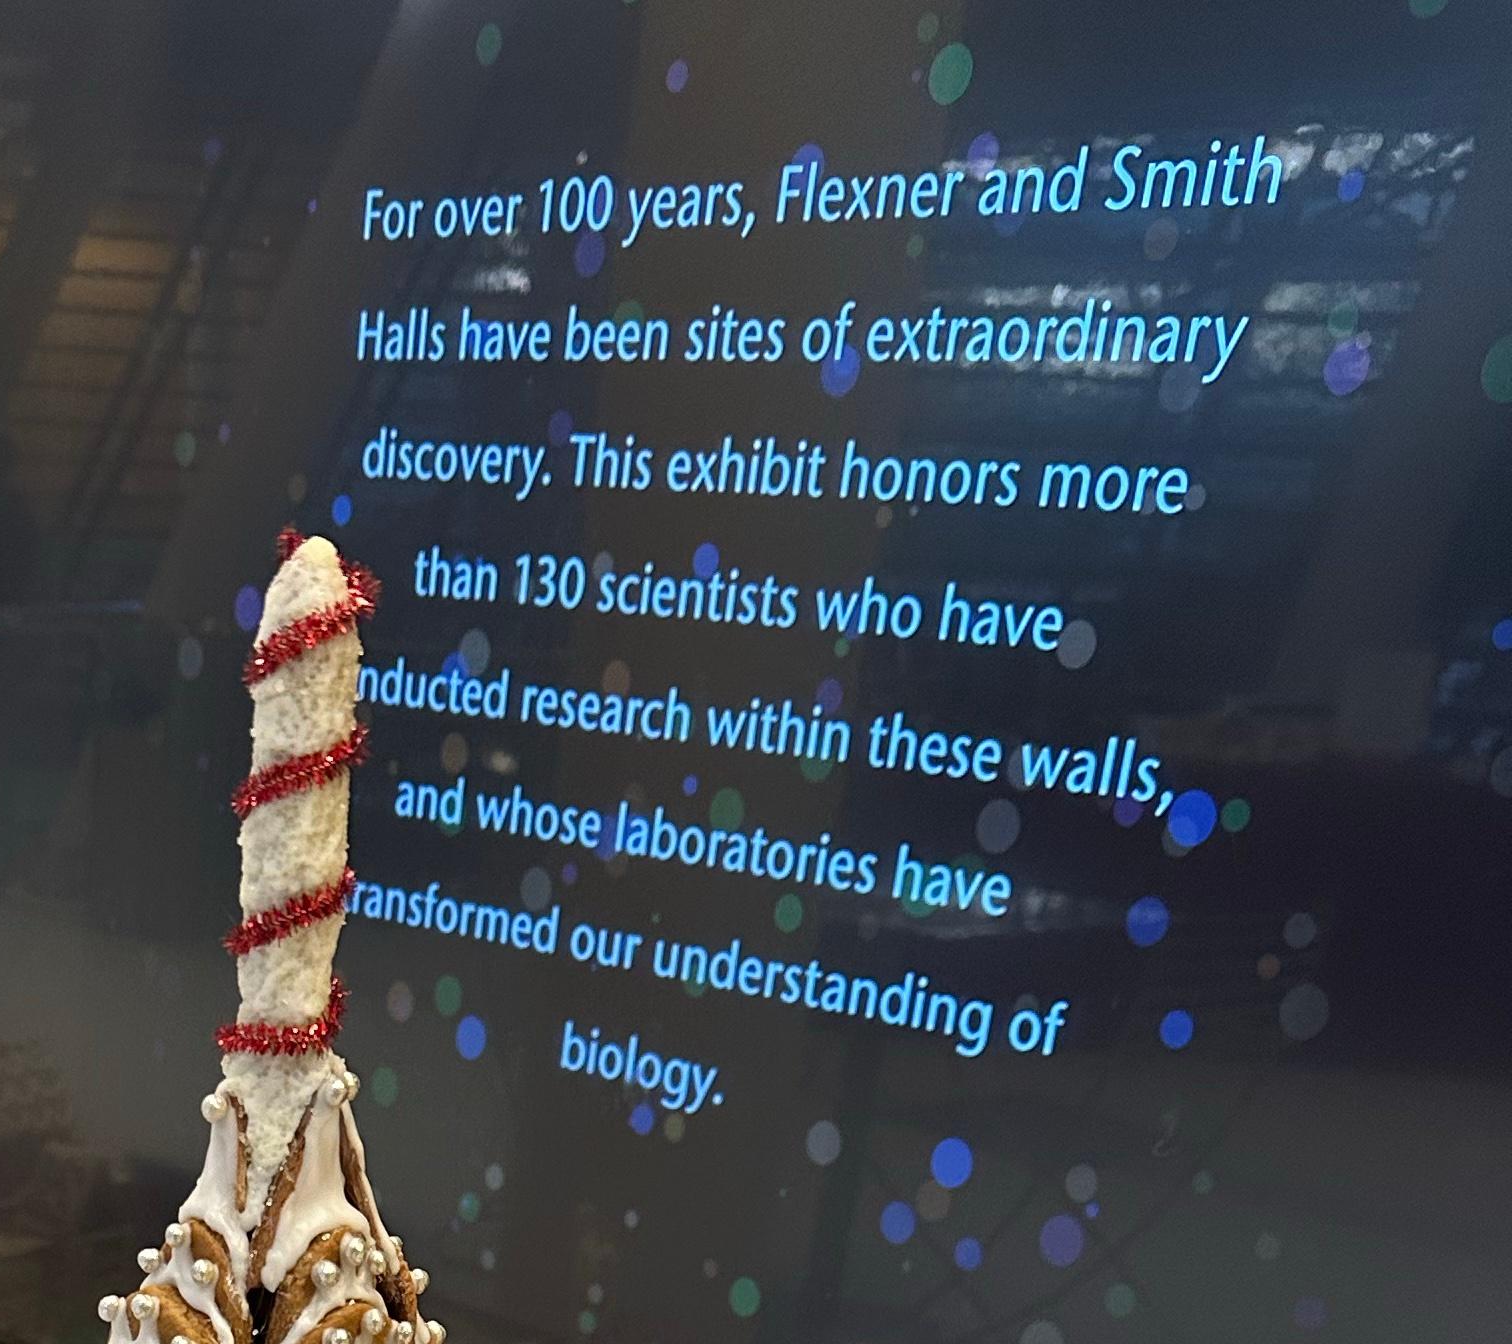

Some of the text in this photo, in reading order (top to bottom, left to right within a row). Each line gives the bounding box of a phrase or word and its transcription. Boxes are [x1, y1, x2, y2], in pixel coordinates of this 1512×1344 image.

[362, 134, 1291, 249] For over 100 years, Flexner and Smith
[356, 297, 1251, 386] Halls have been sites of extraordinary
[361, 425, 1189, 515] discovery. This exhibit honors more
[413, 545, 1065, 652] than 130 scientists who have
[358, 655, 1175, 818] nducted research within these walls,
[393, 776, 1013, 917] and whose laboratories have
[569, 923, 644, 970] our
[651, 938, 994, 1060] understanding
[1007, 1000, 1070, 1057] of
[559, 1020, 724, 1115] biology.
